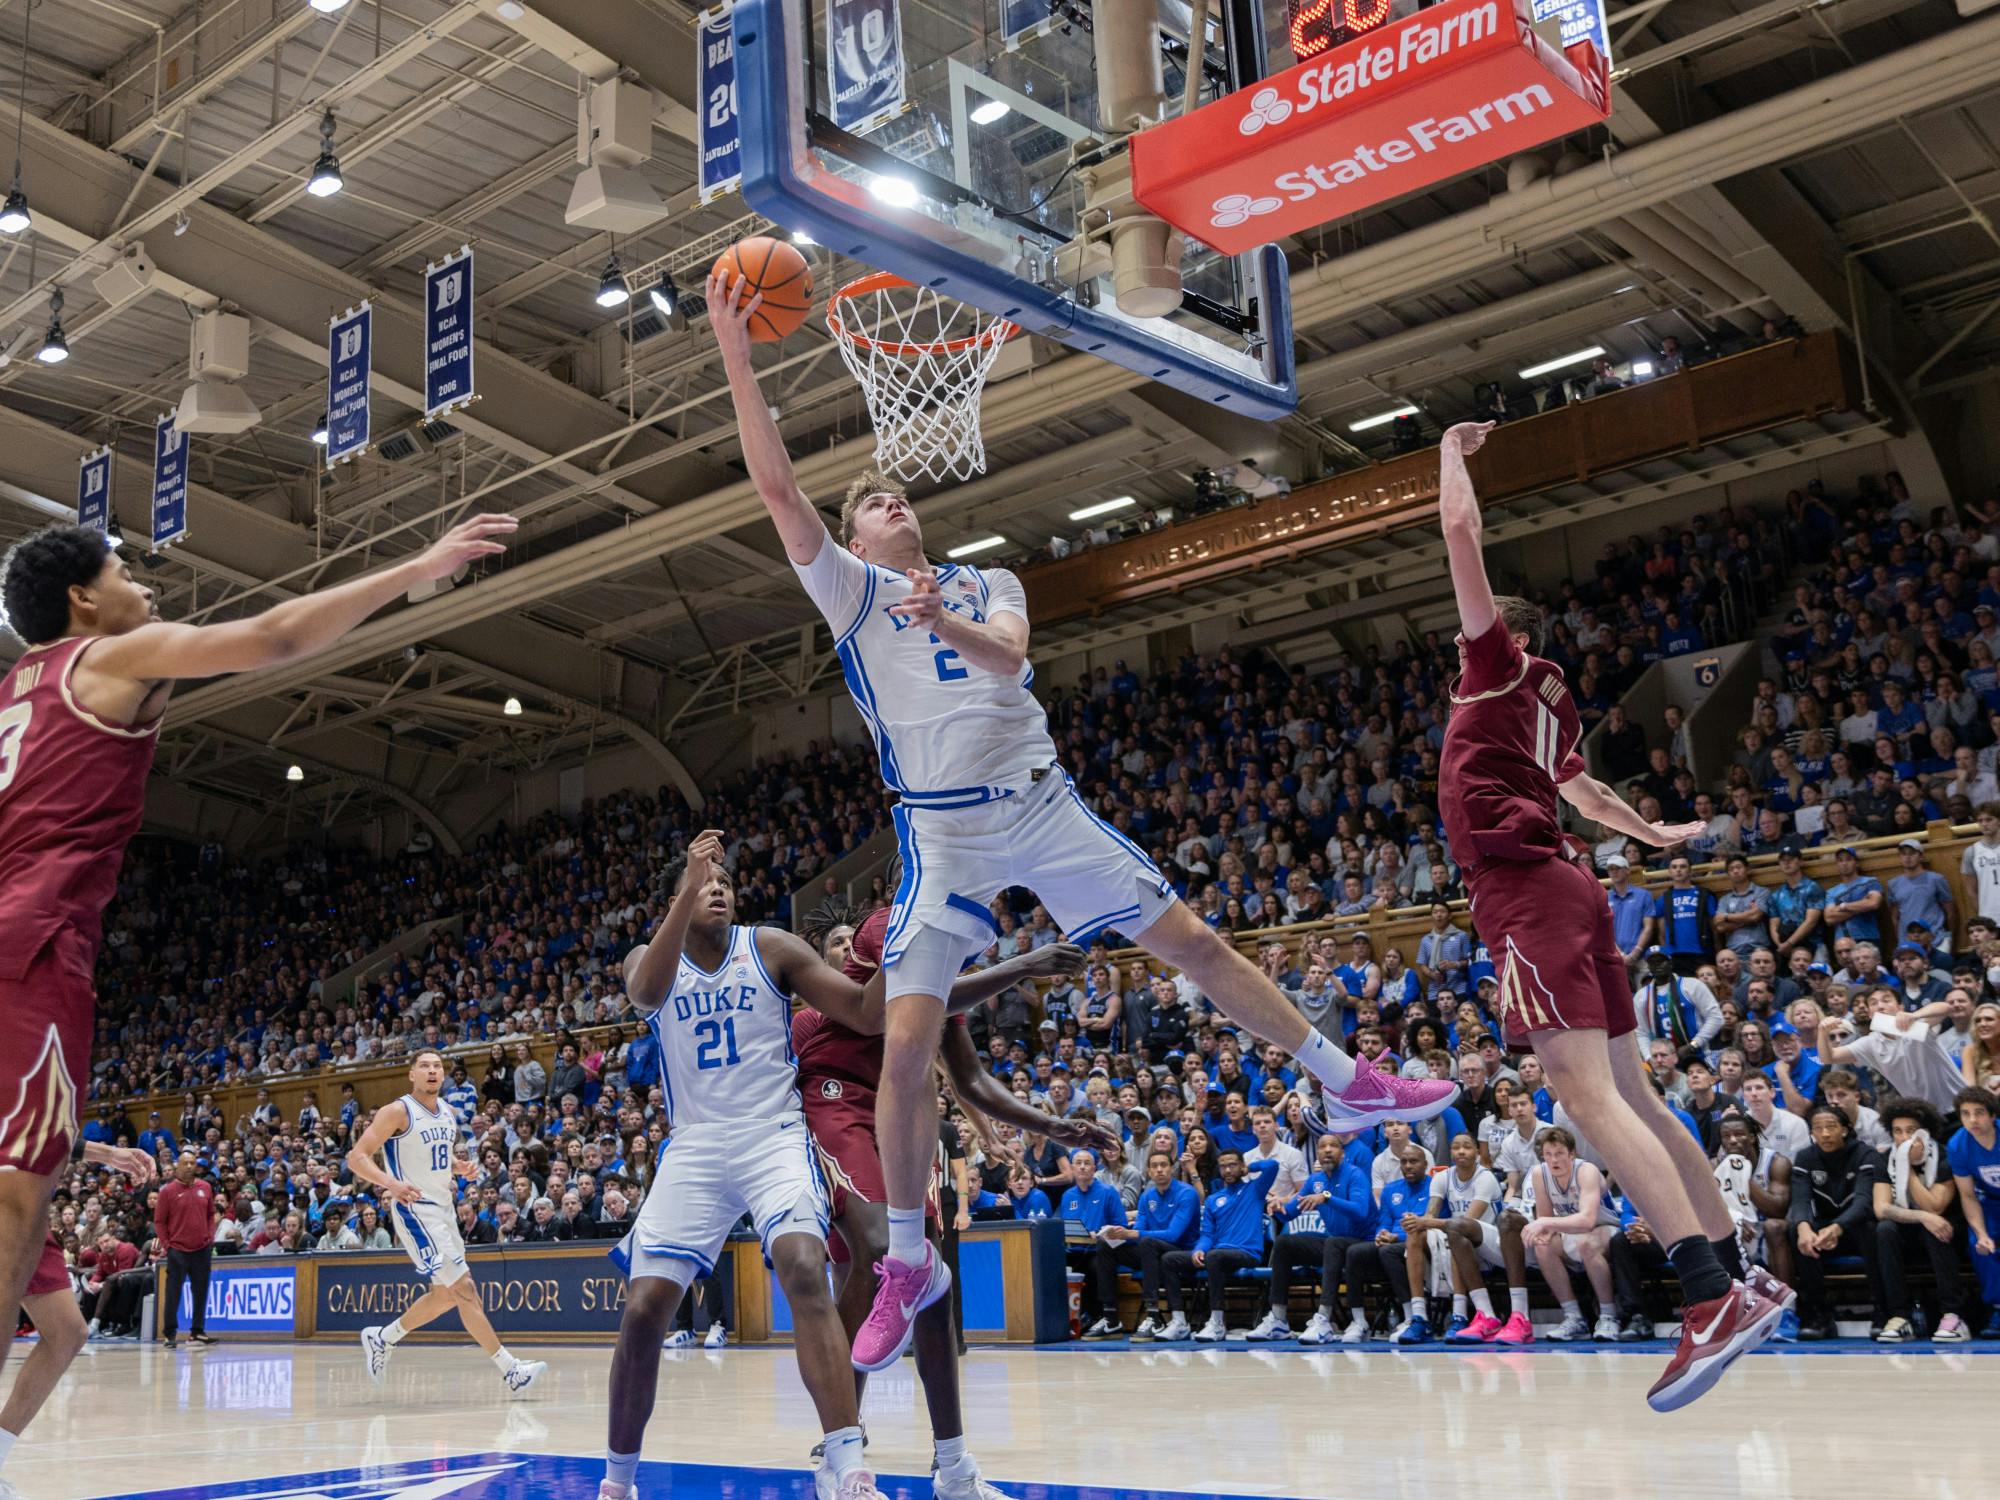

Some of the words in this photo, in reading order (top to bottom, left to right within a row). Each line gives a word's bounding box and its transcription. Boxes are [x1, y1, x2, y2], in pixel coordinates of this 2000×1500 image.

[438, 314, 457, 333] NCAA
[431, 329, 464, 353] WOMEN'S
[429, 357, 447, 374] FINAL
[448, 346, 468, 364] FOUR
[339, 366, 357, 383] NCAA
[334, 381, 363, 403] WOMEN'S
[438, 380, 457, 397] 2006
[329, 405, 348, 422] FINAL
[1122, 532, 1225, 578] CAMERON
[1232, 506, 1321, 546] INDOOR
[1329, 470, 1440, 521] STADIUM
[1701, 666, 1714, 684] 6
[1535, 699, 1559, 783] 11
[675, 985, 757, 1021] DUKE
[694, 1016, 741, 1070] 21
[420, 1126, 457, 1145] DUKE
[431, 1143, 449, 1171] 18
[1288, 1212, 1326, 1235] DUKE
[231, 1281, 291, 1316] NEWS
[328, 1282, 427, 1314] CAMERO
